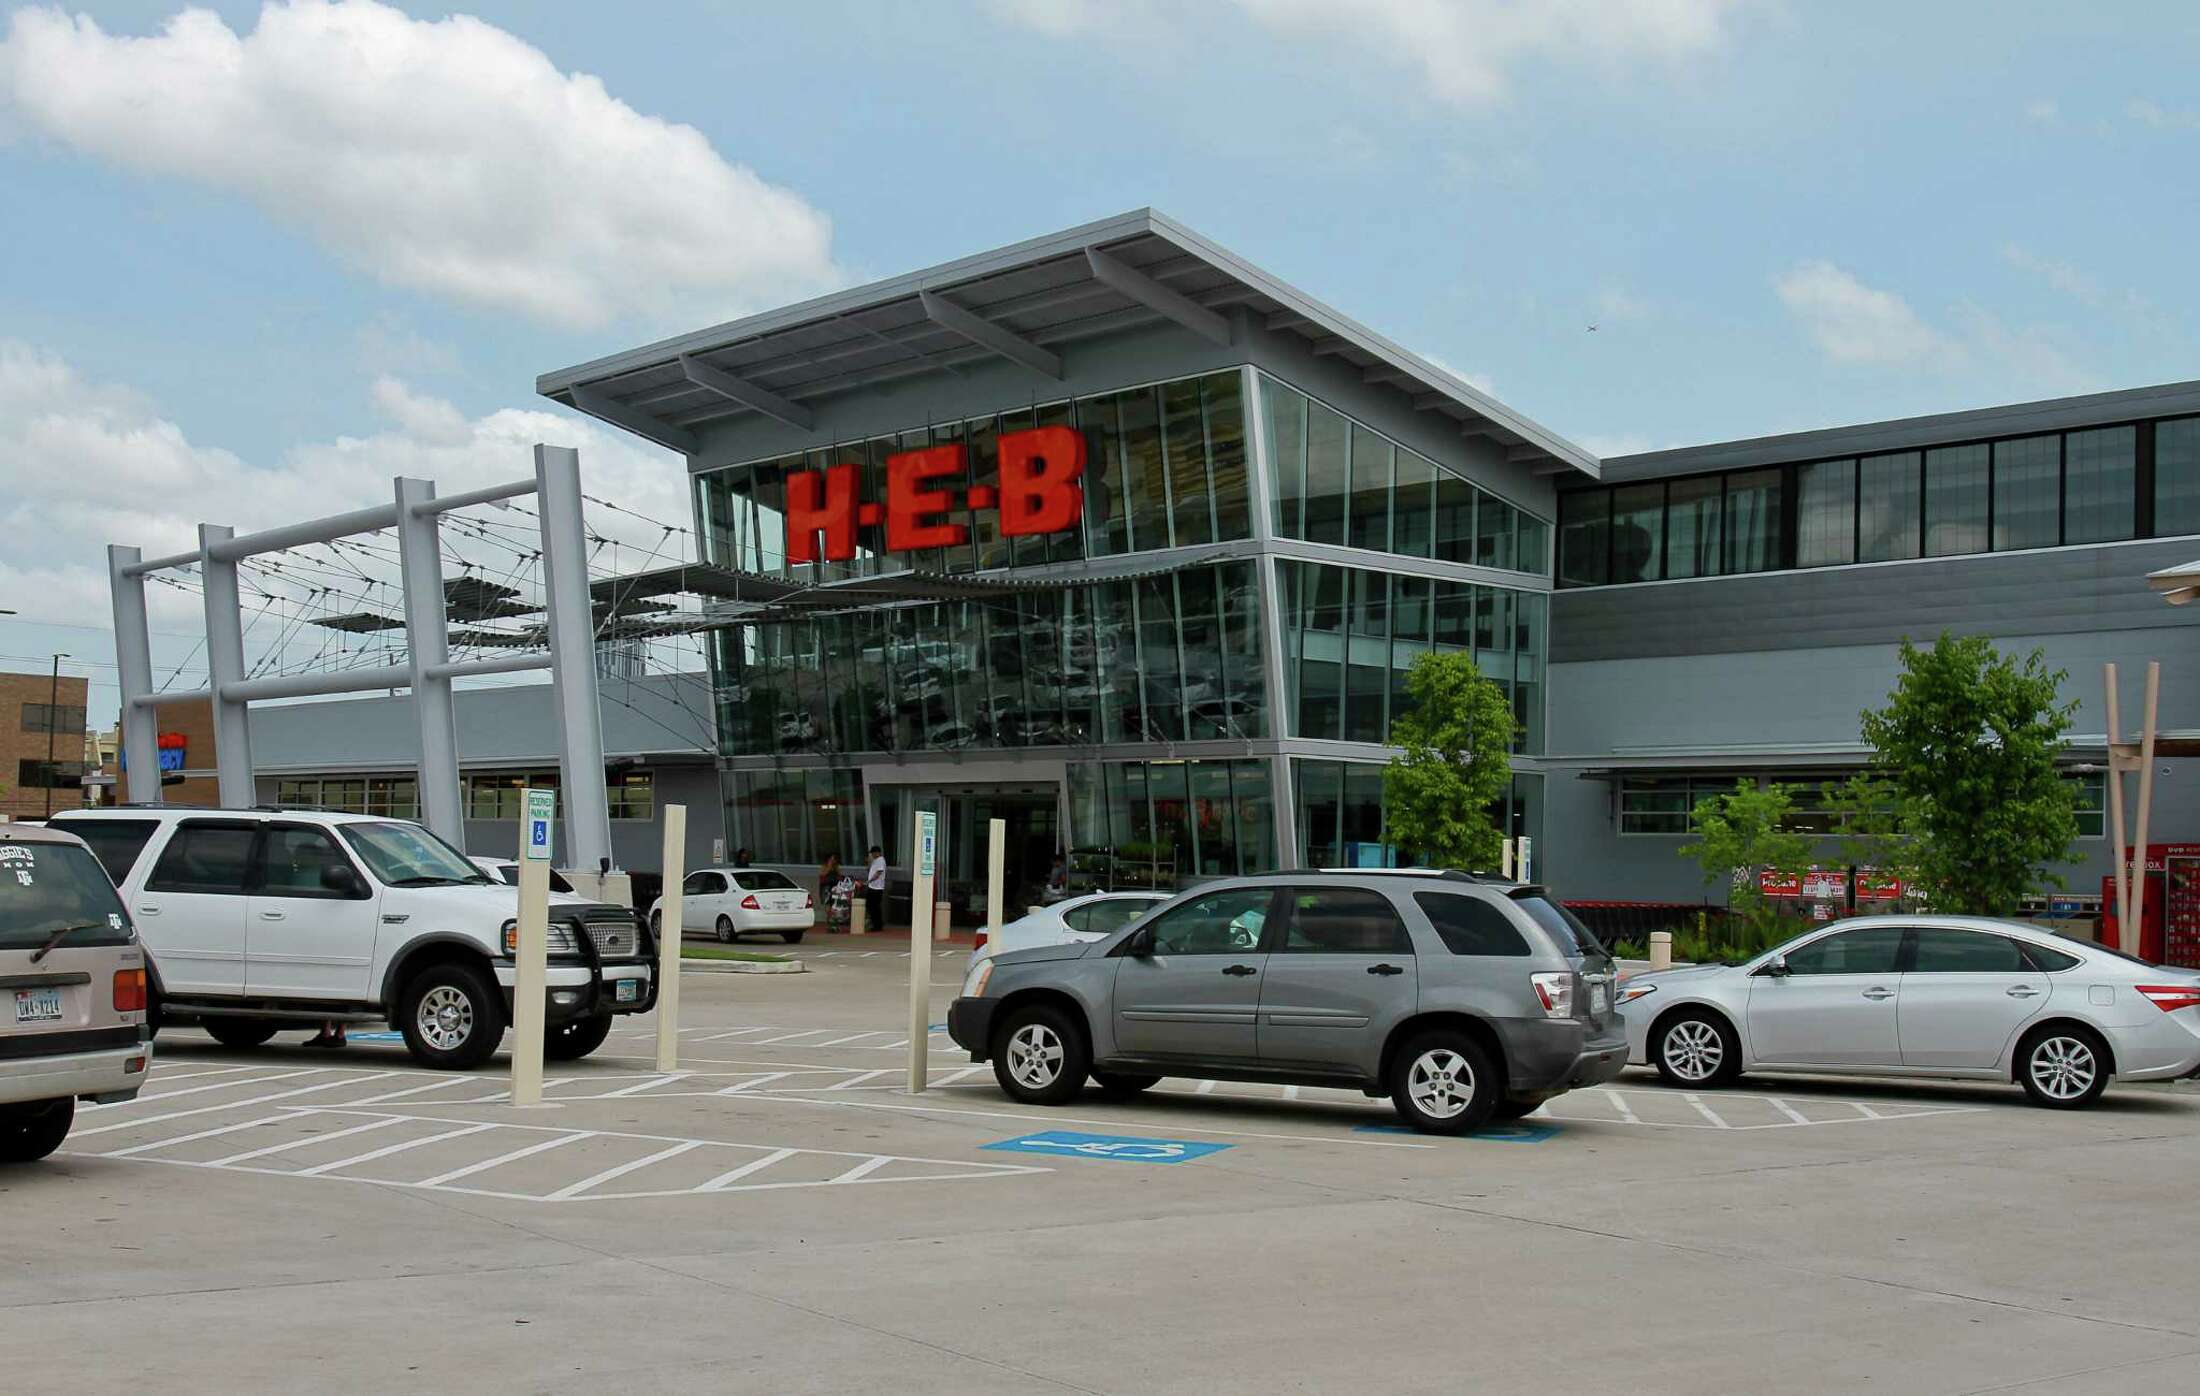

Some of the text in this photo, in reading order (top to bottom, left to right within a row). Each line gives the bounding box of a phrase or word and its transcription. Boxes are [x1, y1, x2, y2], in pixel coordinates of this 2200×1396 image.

[786, 425, 1086, 563] H-E-B
[530, 808, 551, 818] PARKING
[0, 846, 34, 860] GGIES
[2126, 861, 2161, 869] reox
